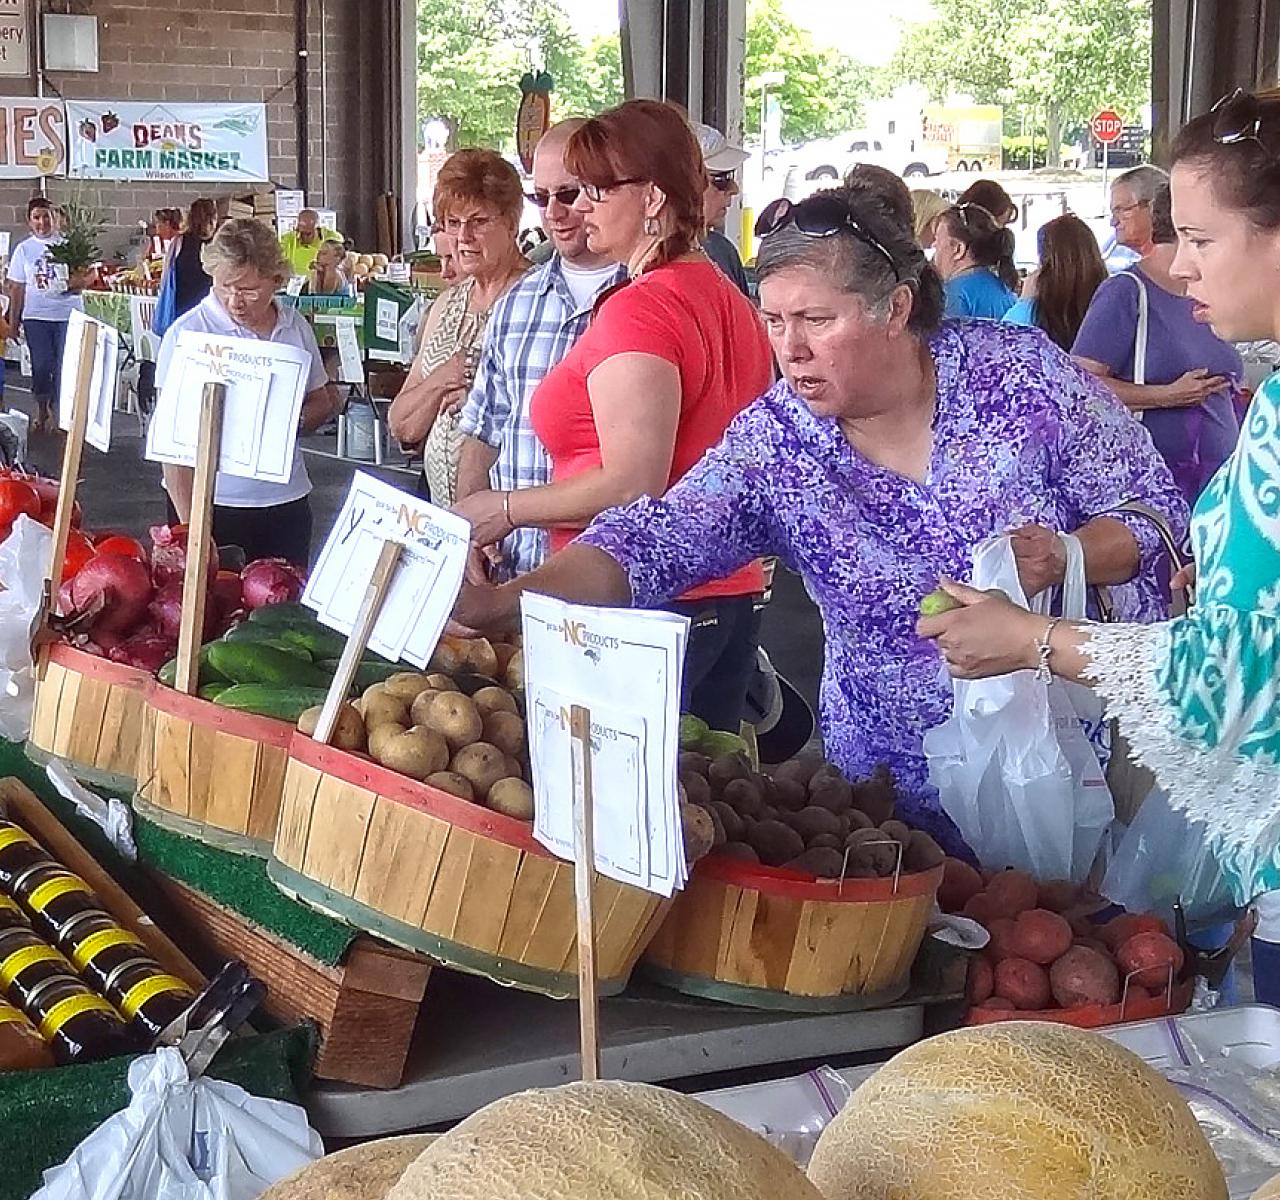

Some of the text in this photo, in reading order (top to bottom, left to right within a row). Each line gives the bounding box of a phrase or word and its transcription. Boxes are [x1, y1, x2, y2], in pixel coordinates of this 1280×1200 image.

[133, 124, 202, 149] DEANS
[1094, 119, 1121, 132] STOP
[95, 149, 241, 171] FARM MARKET
[181, 171, 195, 179] NC
[227, 351, 273, 367] PRODUCTS
[396, 504, 432, 536] NC
[563, 618, 588, 648] NC
[582, 629, 619, 649] PRODUCTS
